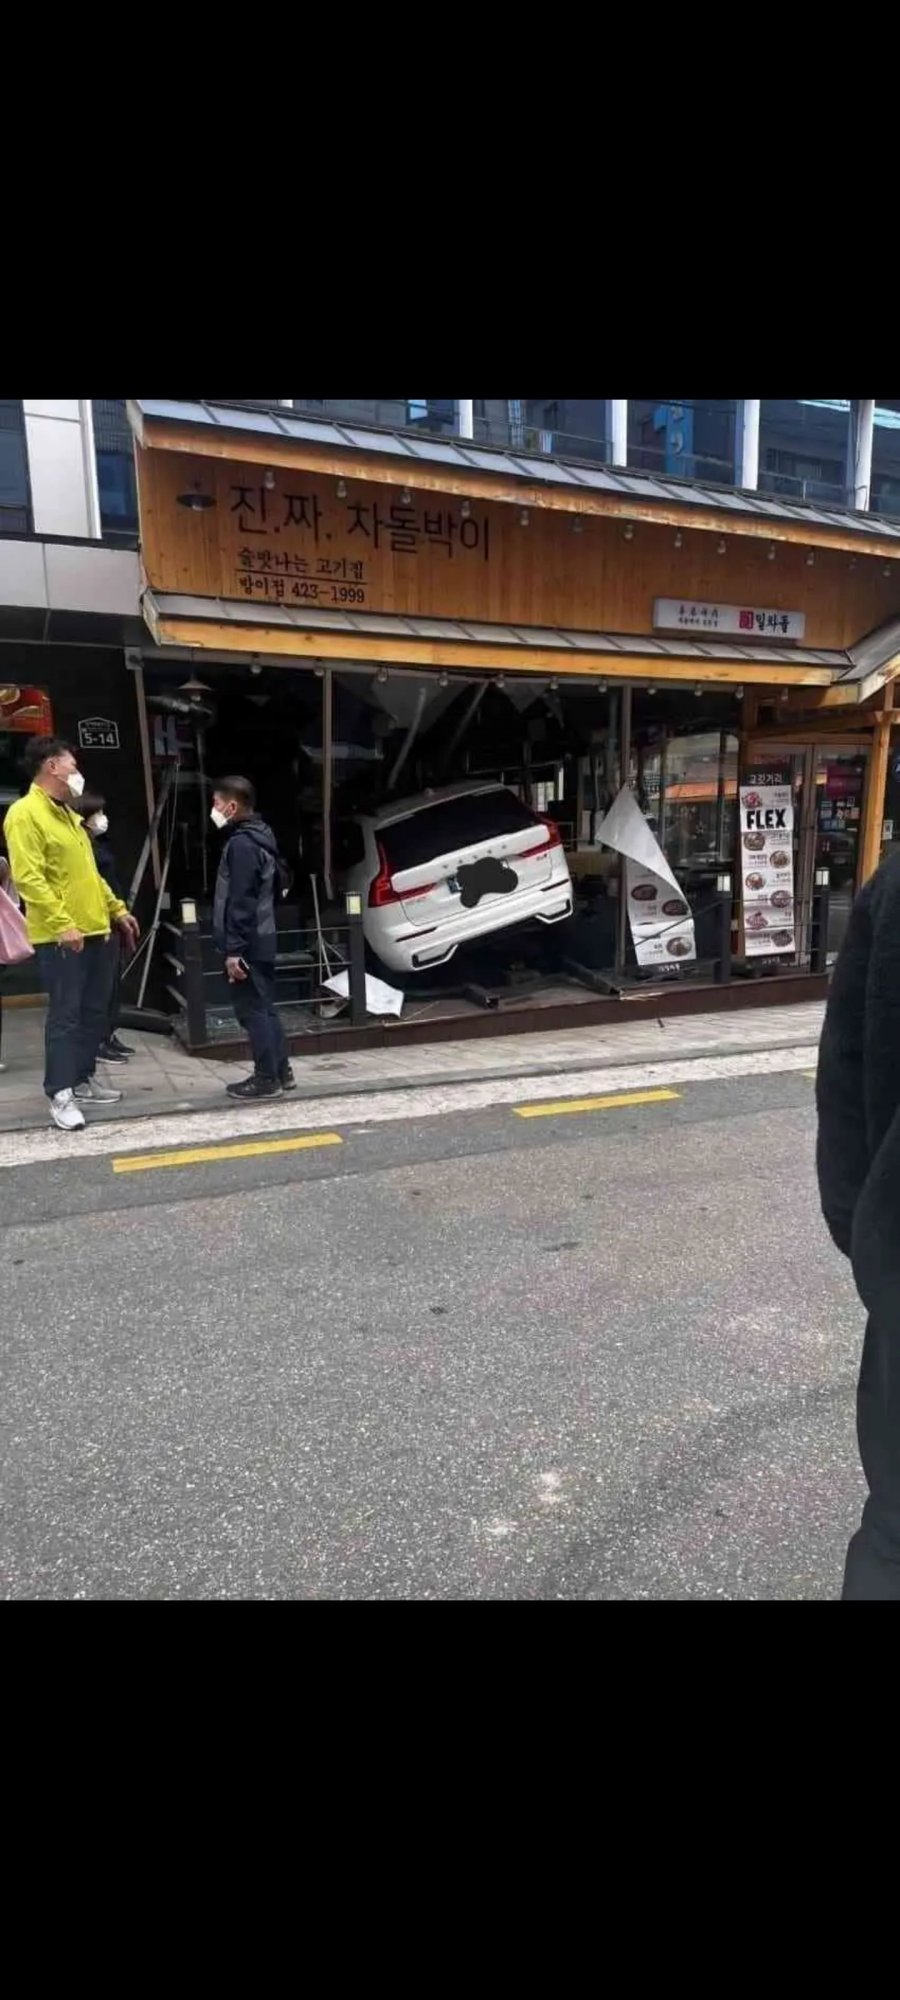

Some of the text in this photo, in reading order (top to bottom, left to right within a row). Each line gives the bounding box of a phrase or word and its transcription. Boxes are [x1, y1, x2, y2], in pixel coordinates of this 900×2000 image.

[346, 502, 489, 560] 차돌박이
[239, 575, 365, 604] 방이점 423-1999
[84, 732, 115, 745] 5-14
[746, 808, 787, 830] FLEX
